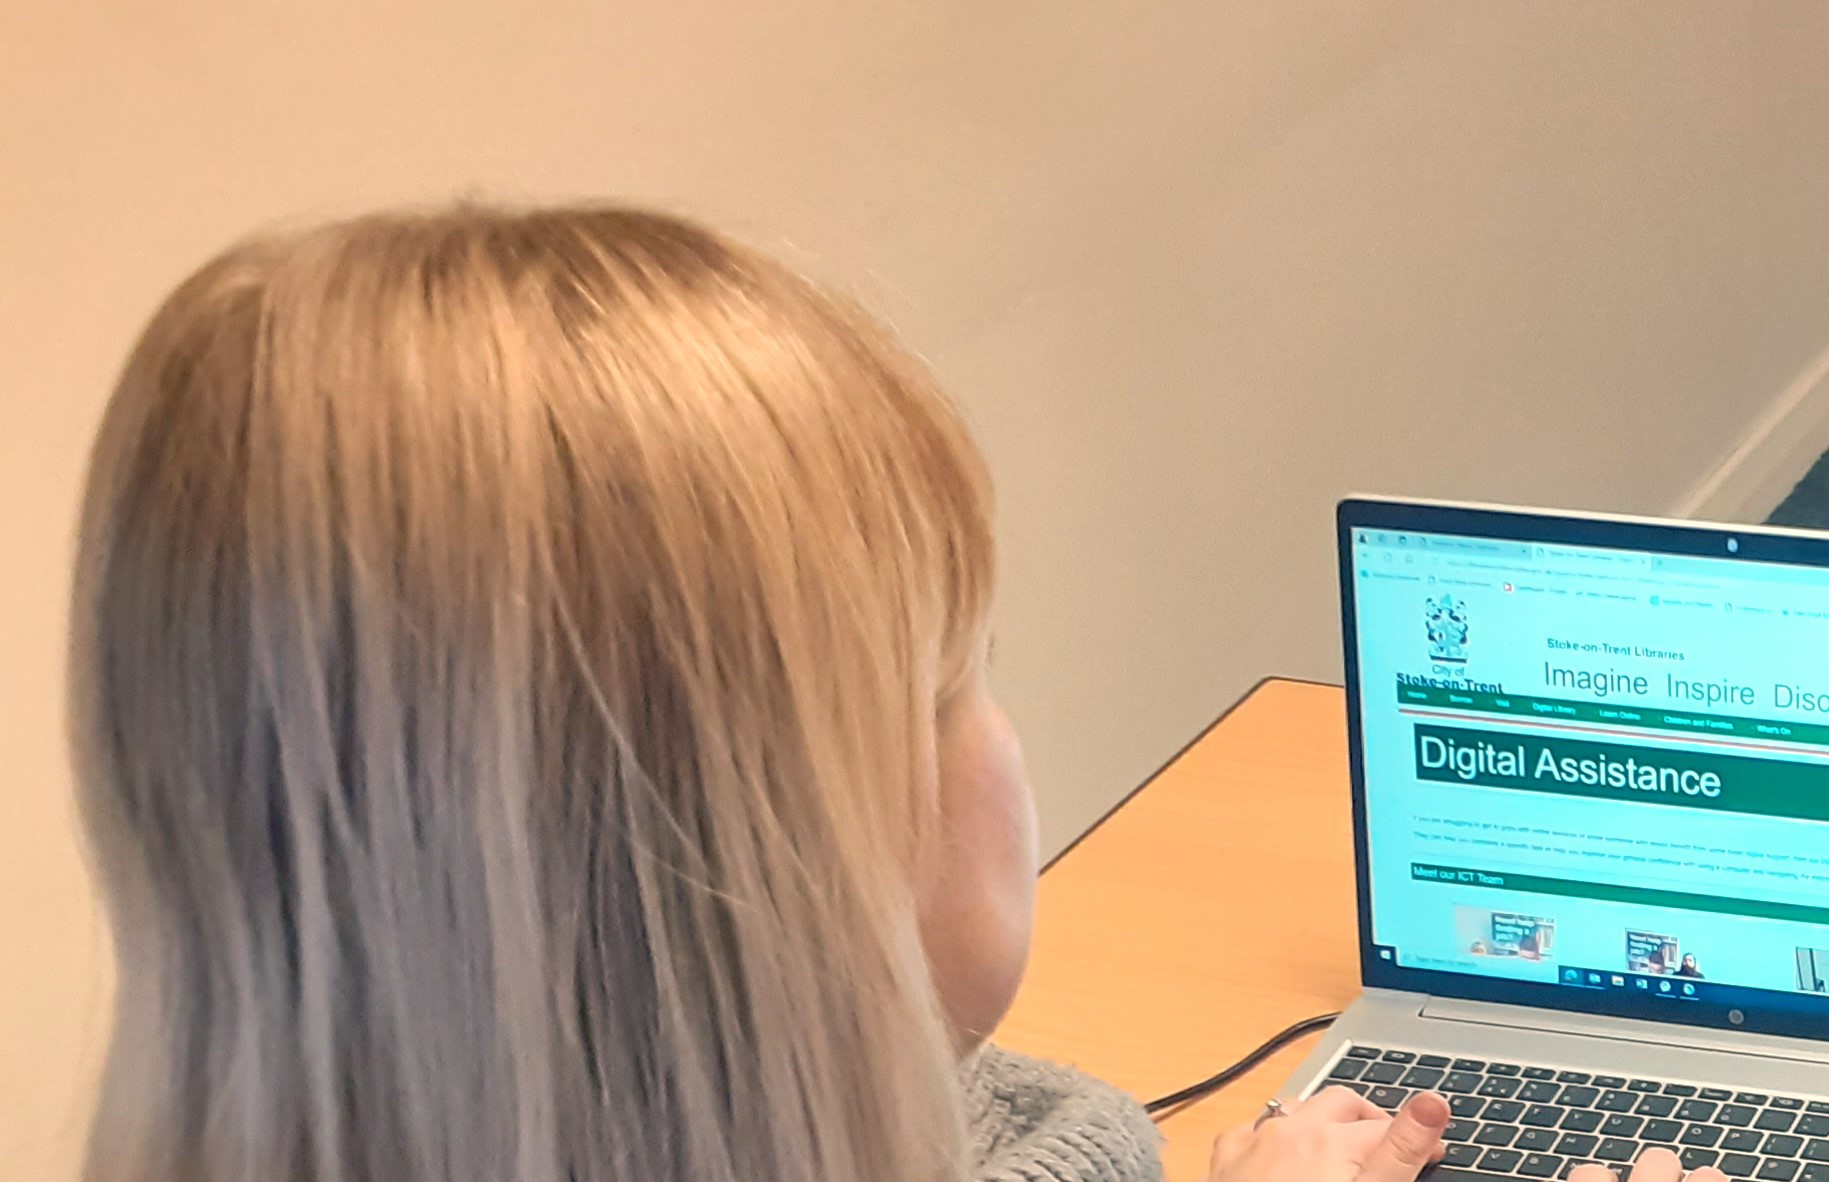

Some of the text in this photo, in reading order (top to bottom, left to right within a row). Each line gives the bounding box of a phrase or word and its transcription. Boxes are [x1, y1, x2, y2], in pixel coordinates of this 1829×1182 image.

[1547, 638, 1685, 661] Stoke-on-Trent Libraries
[1432, 664, 1465, 678] City of
[1397, 672, 1504, 695] Stoke-on-Trent
[1545, 661, 1649, 697] Imagine
[1667, 673, 1755, 708] Inspire
[1532, 702, 1552, 713] Digital
[1554, 705, 1576, 716] Library
[1705, 719, 1734, 730] Families
[1420, 735, 1722, 798] Digital Assistance
[1413, 866, 1505, 886] Meet our ICT Team
